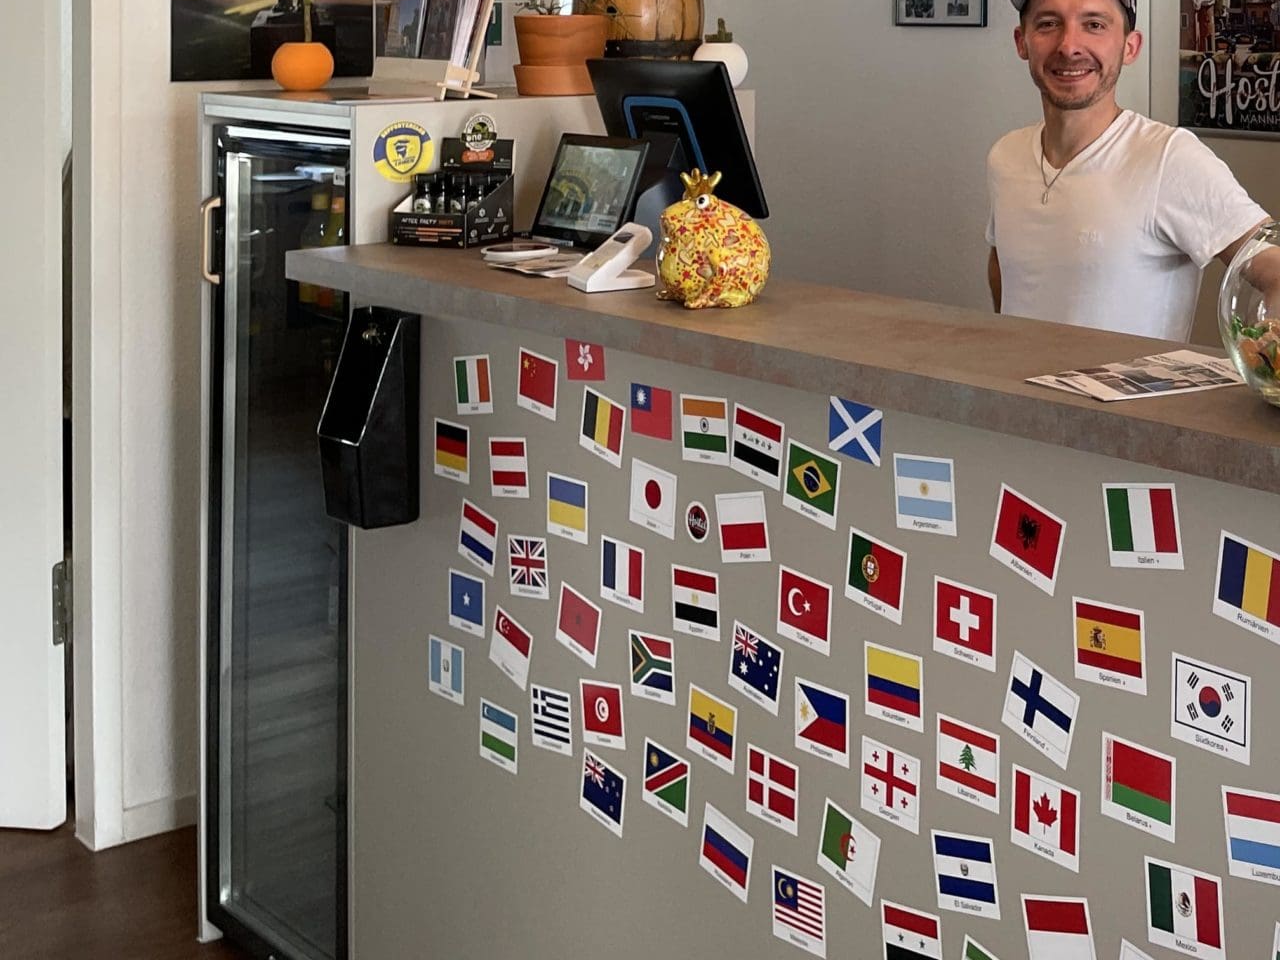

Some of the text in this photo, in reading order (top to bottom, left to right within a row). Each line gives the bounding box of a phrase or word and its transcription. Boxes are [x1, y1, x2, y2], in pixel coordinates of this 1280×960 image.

[1010, 558, 1033, 578] Albanien
[1137, 556, 1155, 565] Italien
[1237, 612, 1269, 634] Rumänien
[1098, 672, 1122, 684] Spanien
[1023, 727, 1046, 749] Finnland
[1126, 812, 1148, 828] Belarus
[1033, 842, 1055, 858] Kanada
[1175, 939, 1197, 953] Mexico
